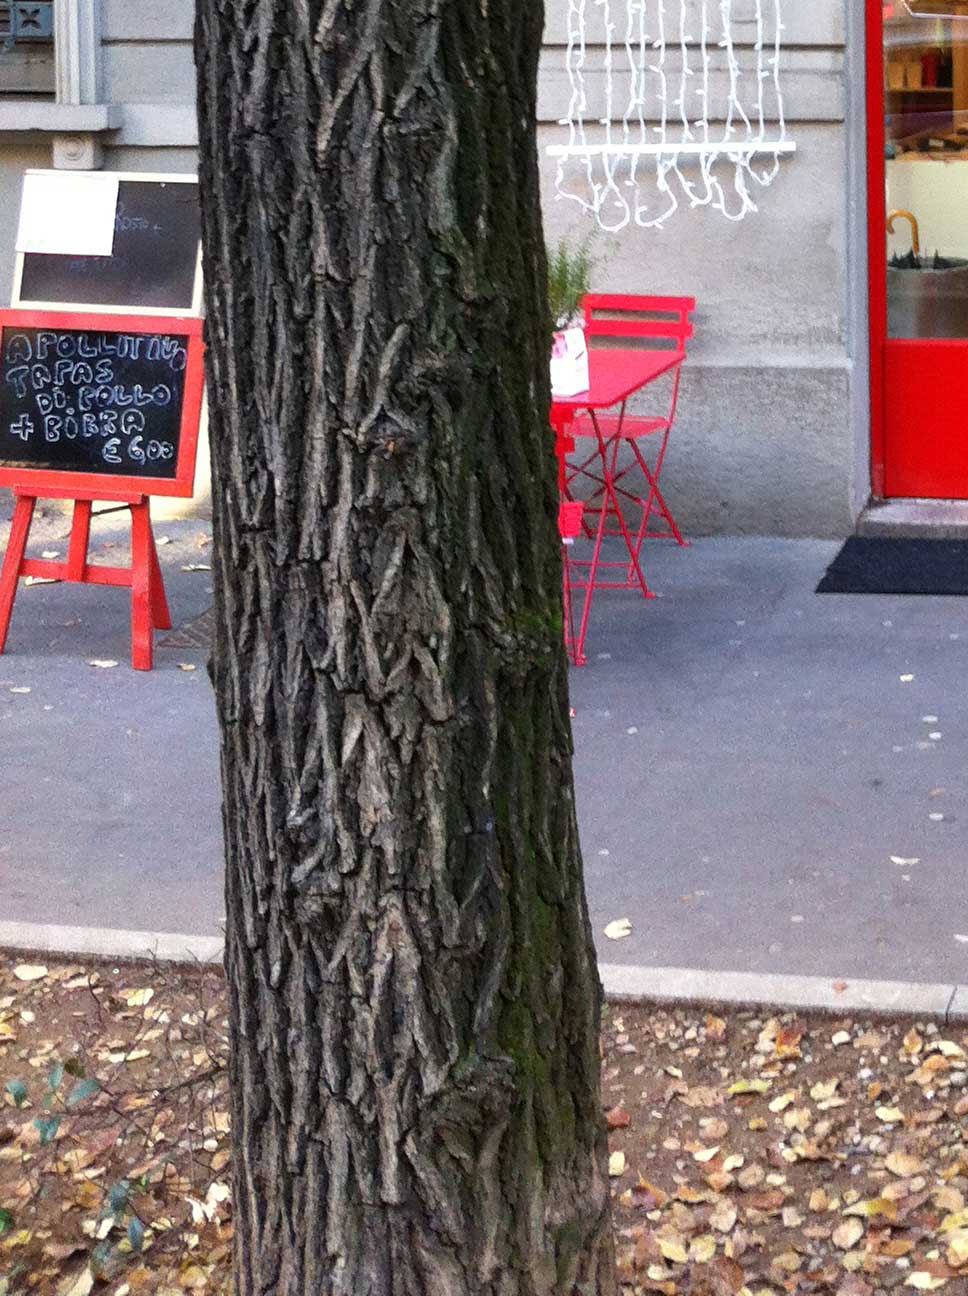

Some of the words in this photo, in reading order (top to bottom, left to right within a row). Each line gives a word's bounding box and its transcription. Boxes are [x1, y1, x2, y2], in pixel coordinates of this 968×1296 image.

[6, 358, 114, 399] TAPAS
[78, 383, 171, 411] POLLO
[10, 413, 34, 441] +
[44, 407, 145, 442] BIRRA
